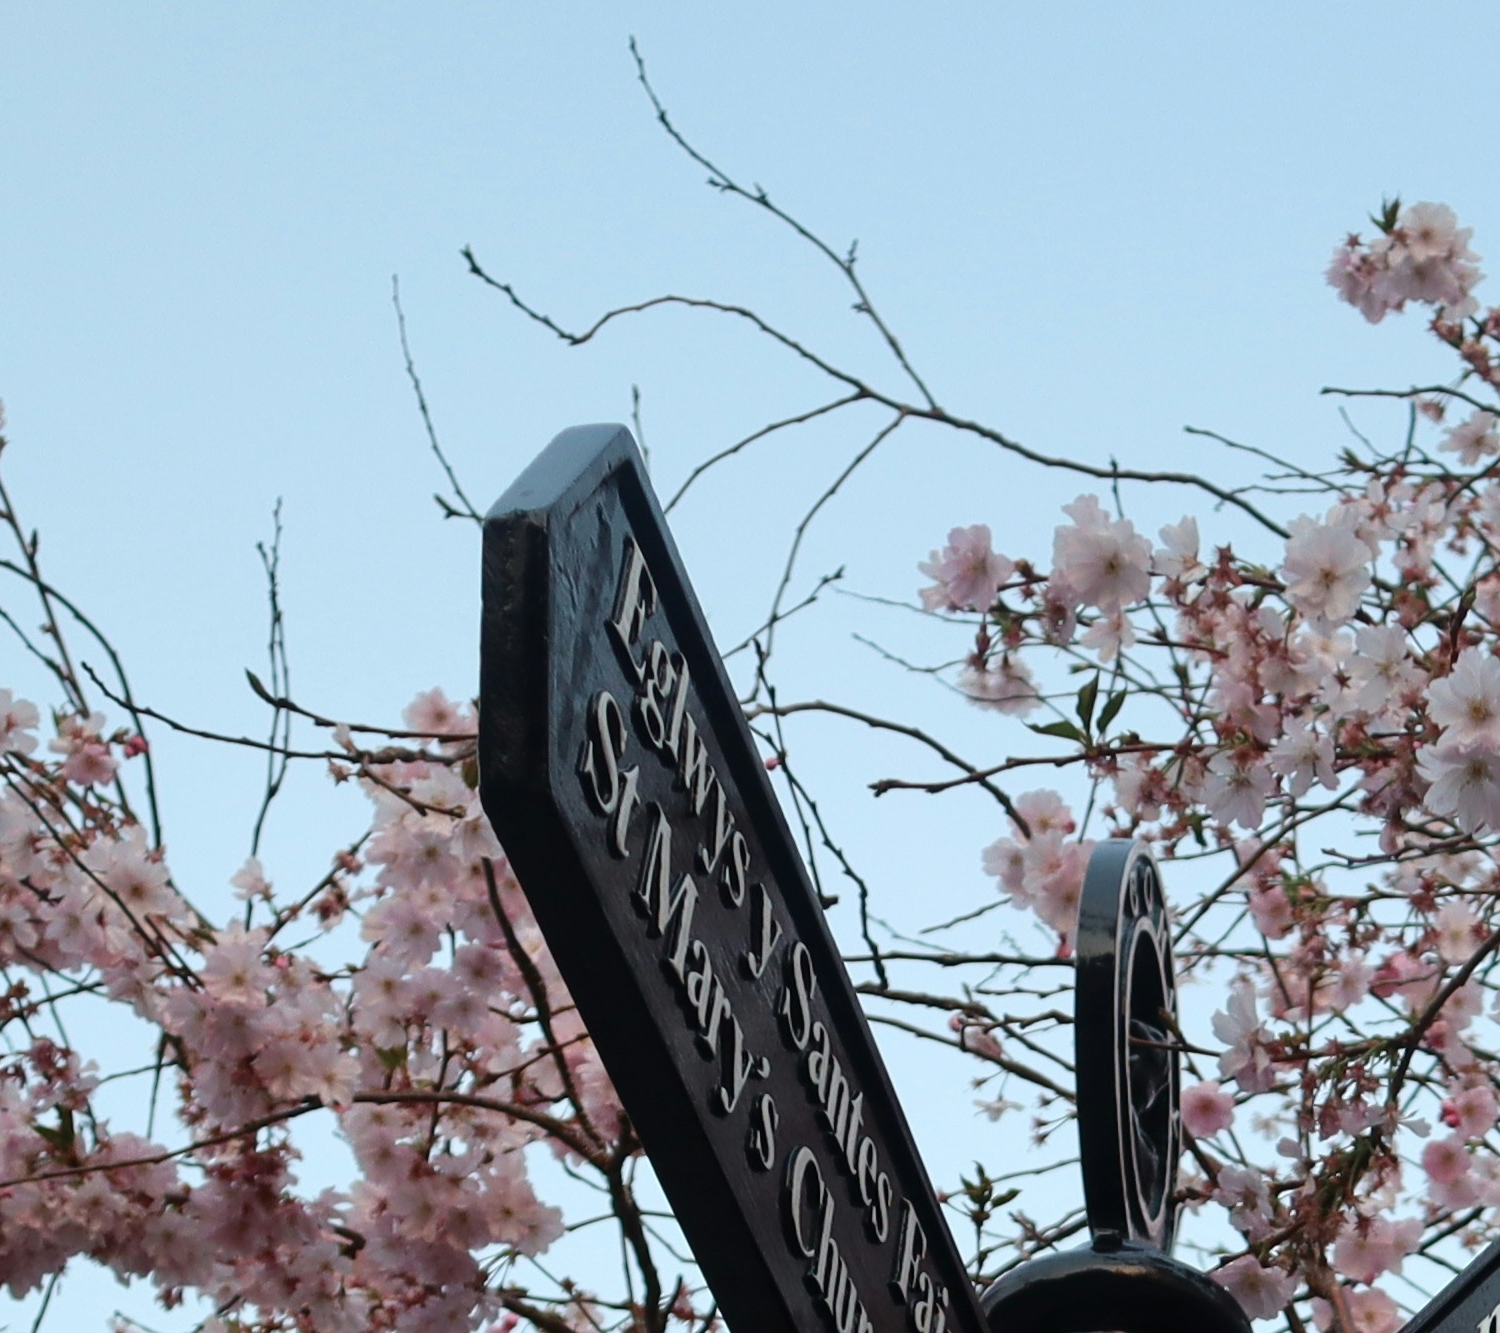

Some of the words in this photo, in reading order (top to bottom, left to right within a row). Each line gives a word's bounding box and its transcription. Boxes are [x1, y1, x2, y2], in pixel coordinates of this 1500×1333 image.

[584, 690, 641, 858] St
[638, 802, 778, 1170] Mary's
[612, 535, 751, 908] Eglwys
[746, 883, 783, 980] y
[783, 940, 893, 1243] Santes
